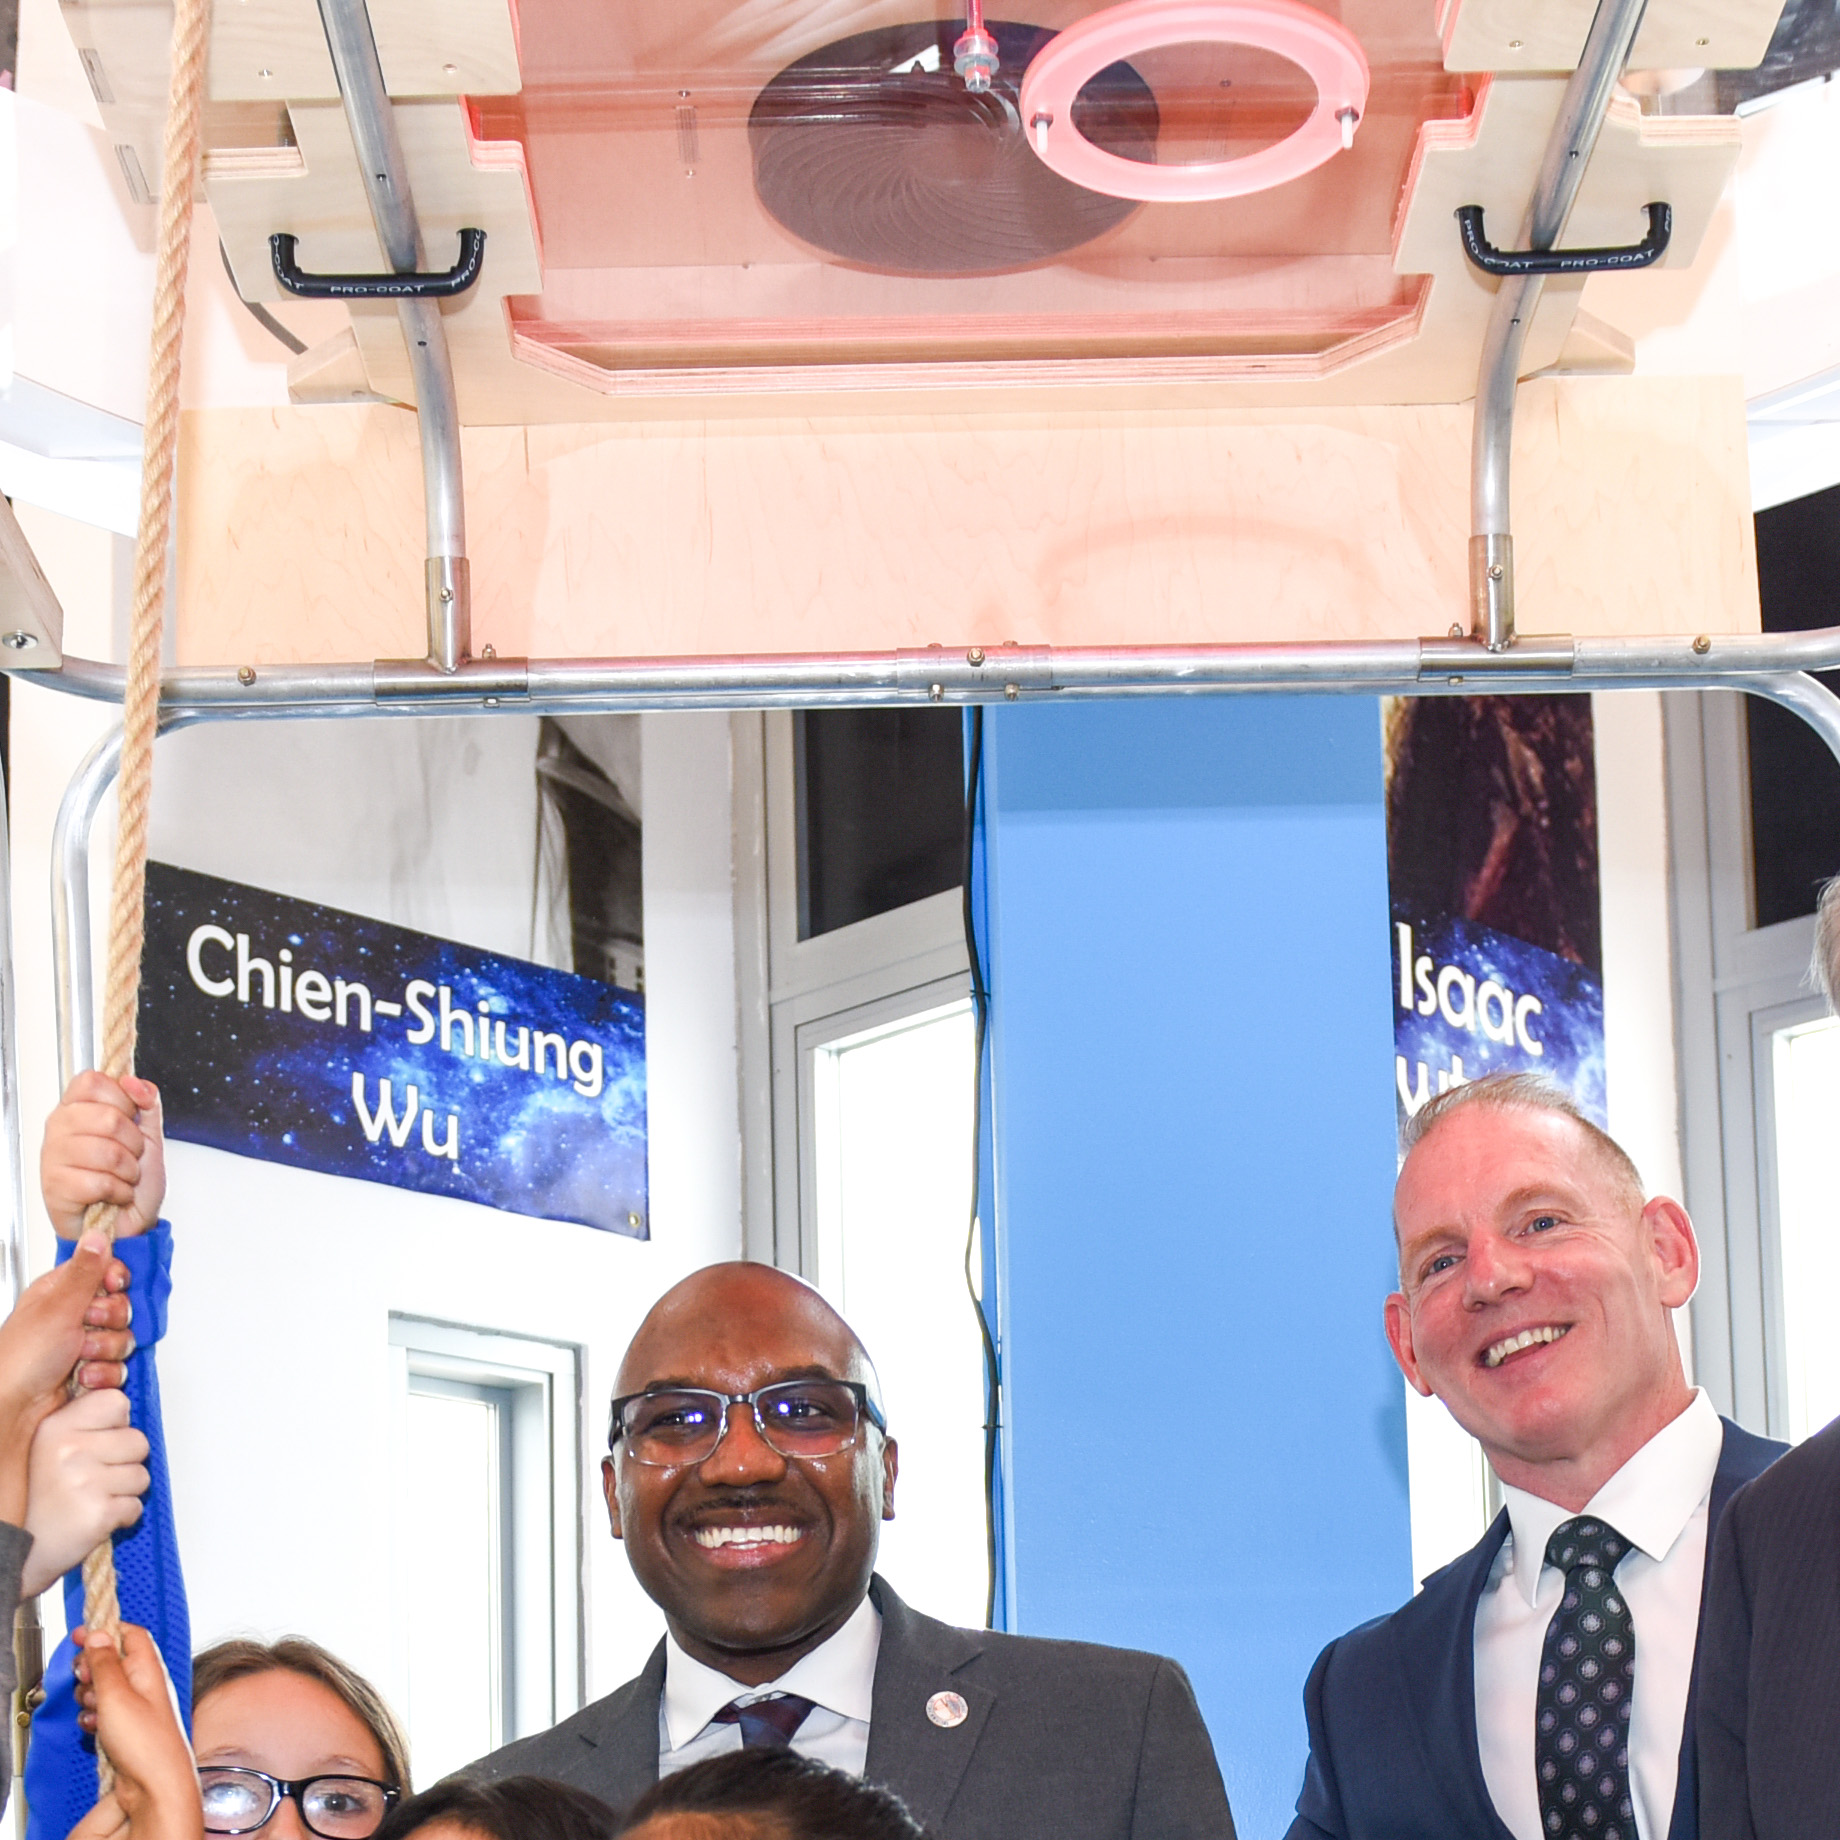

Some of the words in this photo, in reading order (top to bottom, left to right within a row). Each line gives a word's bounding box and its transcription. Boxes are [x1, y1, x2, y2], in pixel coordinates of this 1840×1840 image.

[330, 284, 425, 294] PRO-COAT
[1560, 248, 1655, 268] PRO-COAT
[186, 924, 604, 1098] Chien-Shiung
[1395, 921, 1544, 1057] Isaac
[351, 1071, 460, 1160] Wu
